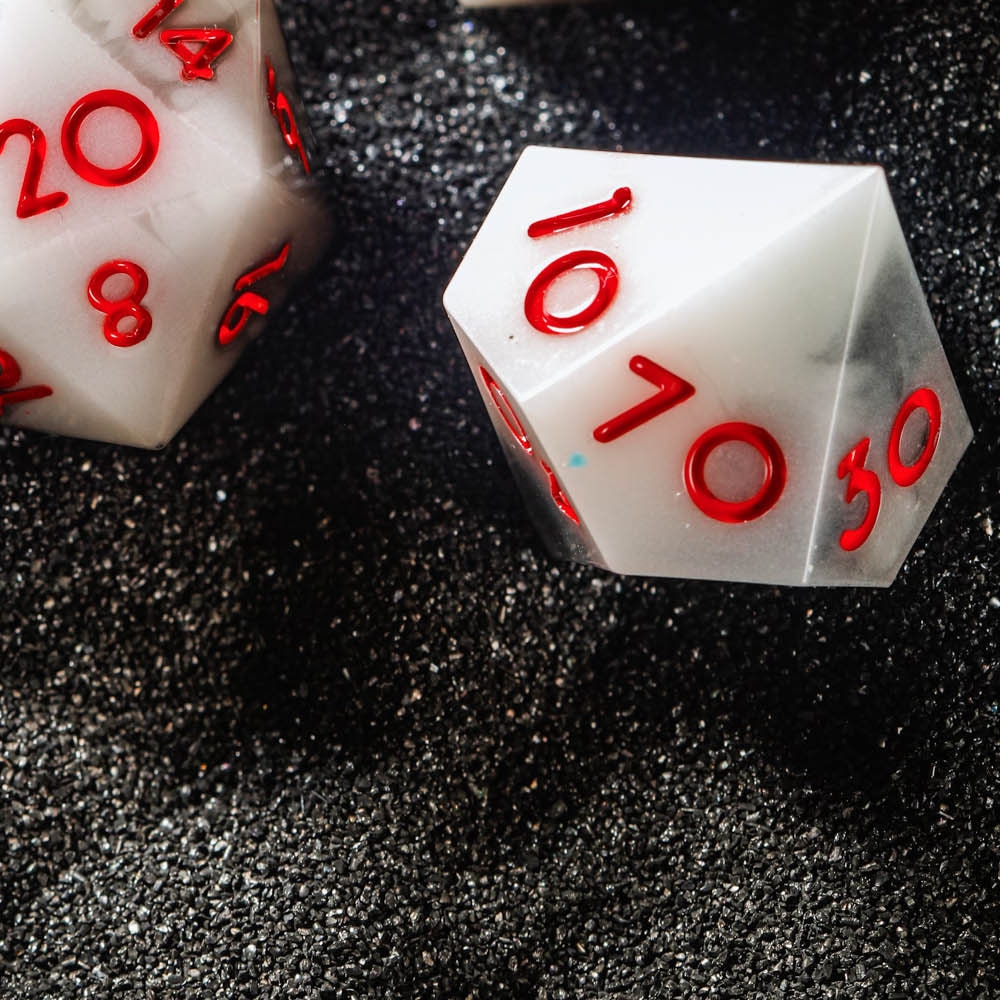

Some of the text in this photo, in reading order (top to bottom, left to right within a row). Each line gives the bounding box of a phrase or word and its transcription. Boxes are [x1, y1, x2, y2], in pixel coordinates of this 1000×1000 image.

[85, 258, 153, 348] 8
[523, 187, 633, 338] 10
[592, 354, 789, 525] 70
[837, 387, 942, 552] 30
